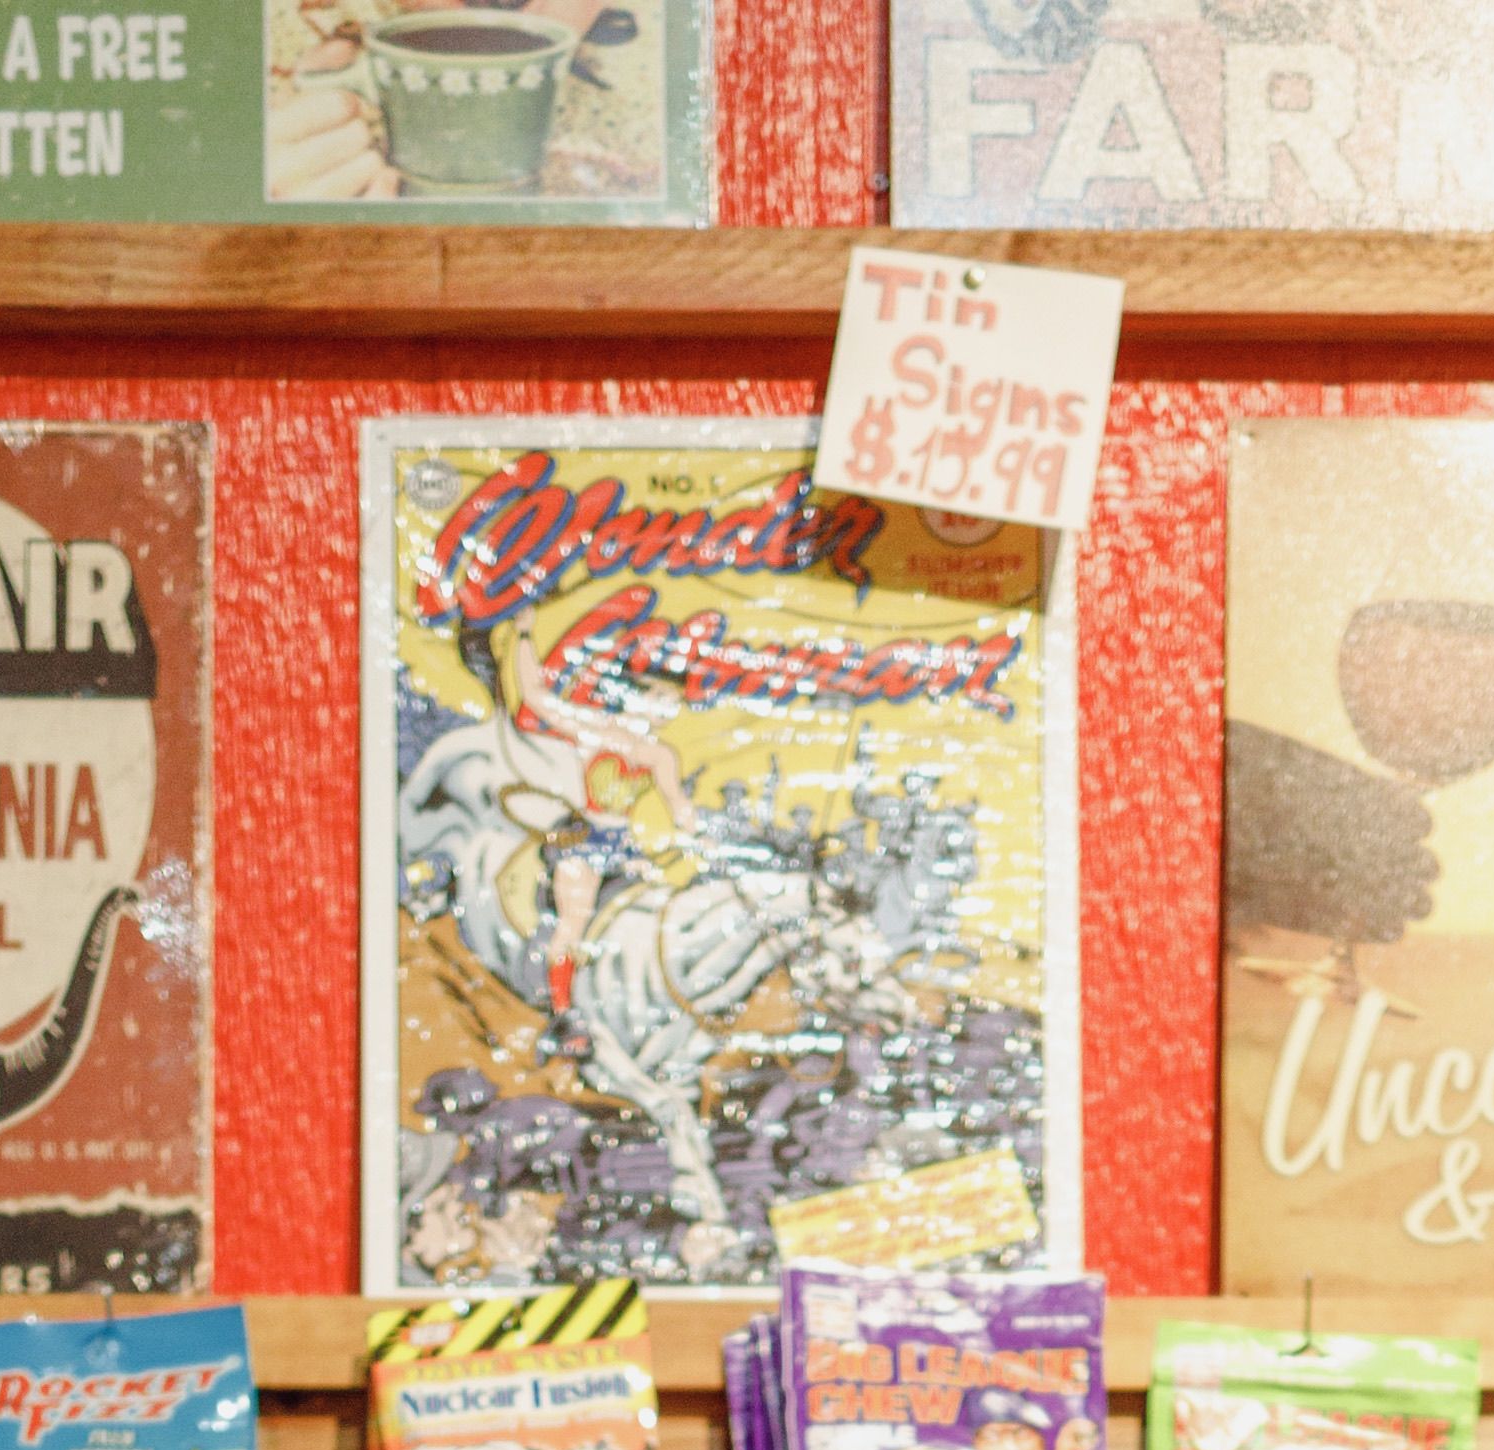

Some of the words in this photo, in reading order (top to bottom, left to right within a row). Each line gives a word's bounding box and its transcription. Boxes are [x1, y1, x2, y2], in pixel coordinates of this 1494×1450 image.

[3, 15, 41, 82] A
[58, 14, 187, 81] FREE
[863, 262, 998, 331] Tin
[891, 334, 1087, 455] Signs
[415, 450, 884, 628] Wonder
[401, 1382, 523, 1418] Nuclear
[531, 1373, 634, 1409] Fusion
[805, 1338, 893, 1383] BIG
[897, 1340, 1091, 1395] LEAGUE
[16, 1396, 189, 1448] FIZZ
[805, 1383, 964, 1425] CHEW
